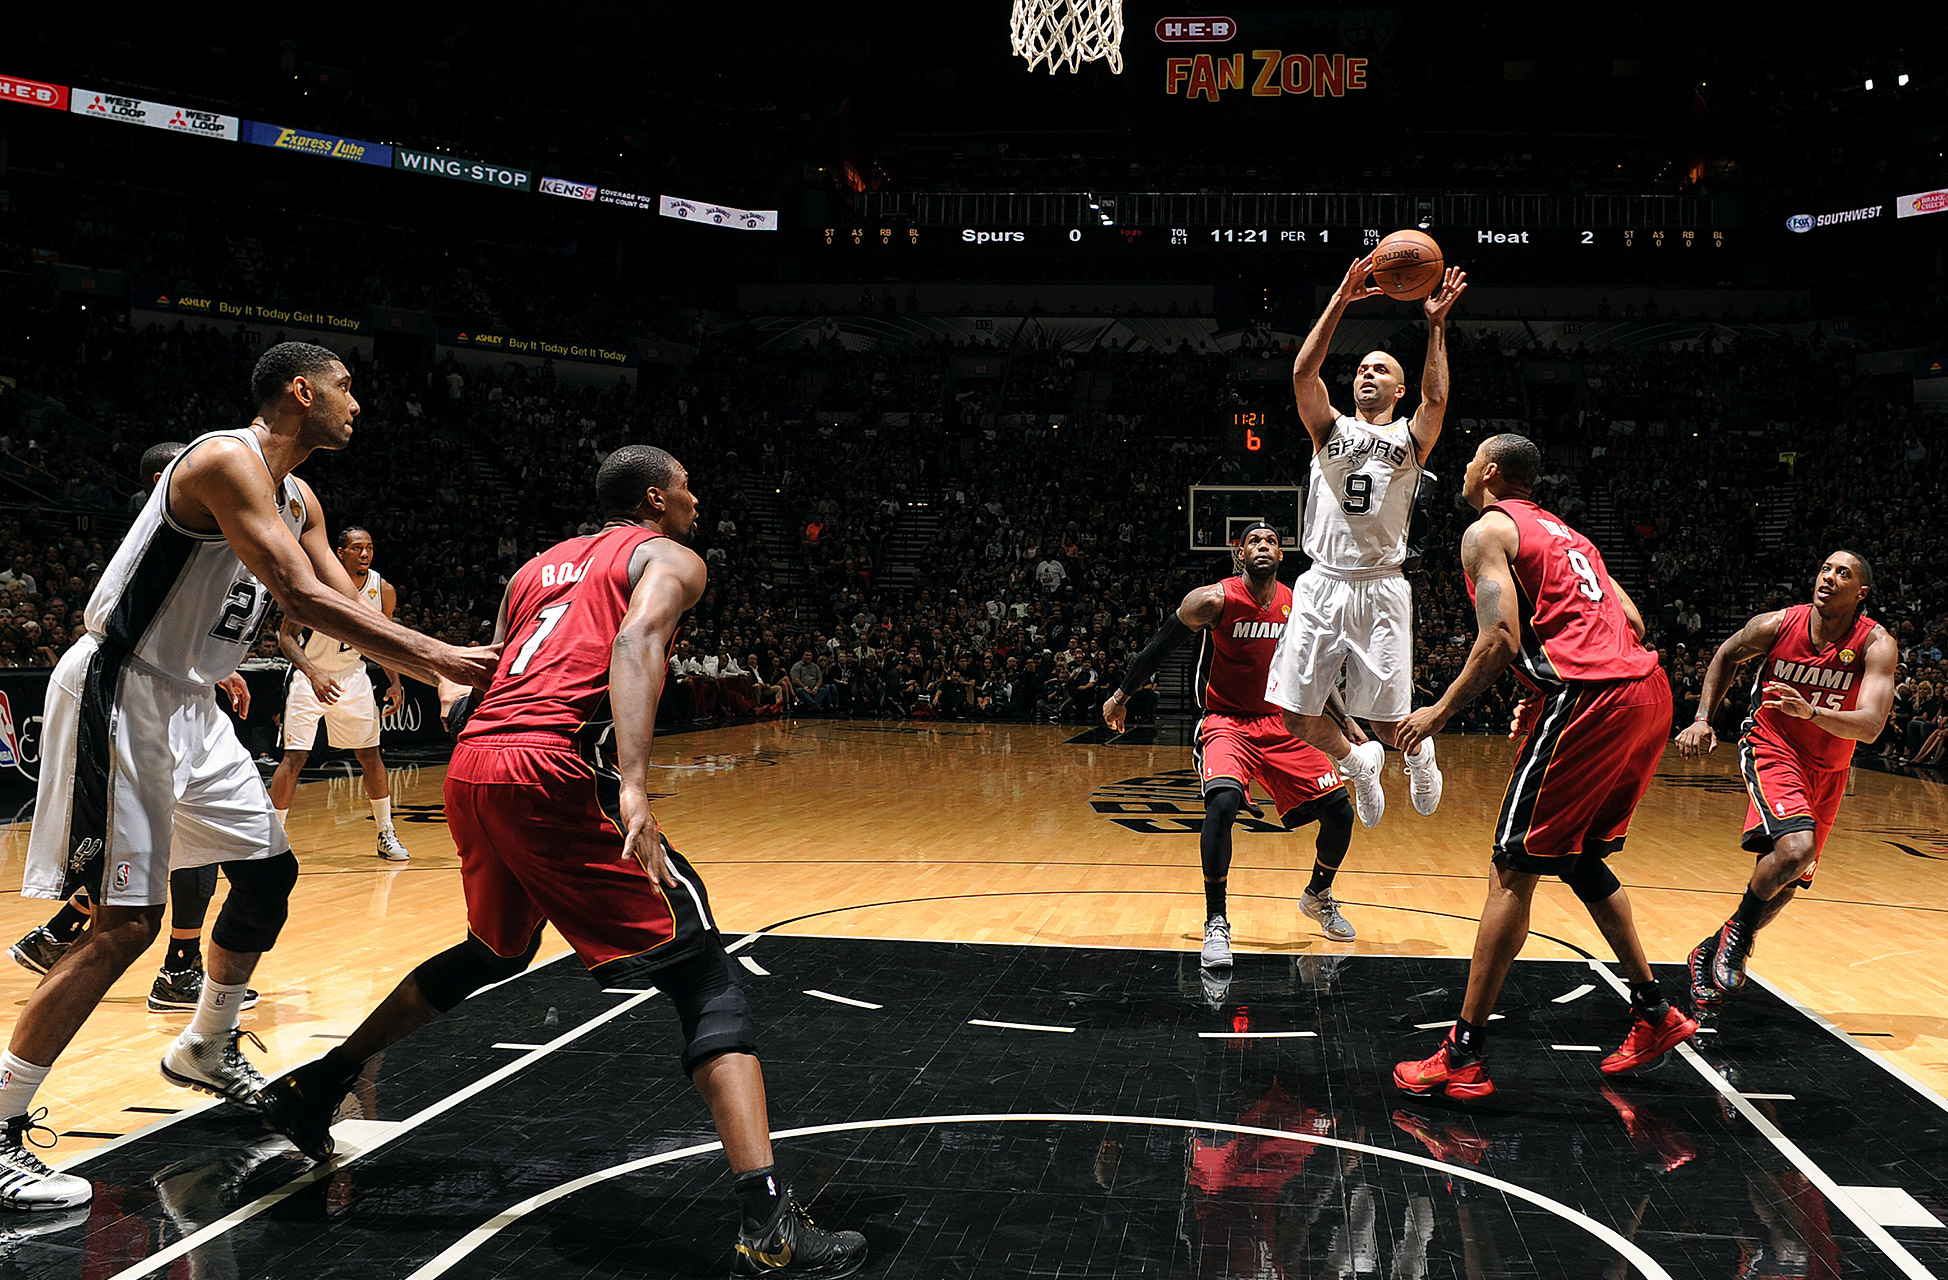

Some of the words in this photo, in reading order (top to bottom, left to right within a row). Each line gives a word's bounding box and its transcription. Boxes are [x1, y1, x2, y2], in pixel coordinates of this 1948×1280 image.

[1166, 53, 1245, 102] FAN
[1251, 49, 1368, 97] ZONE
[104, 95, 141, 109] WEST
[111, 105, 146, 118] LOOP
[185, 110, 220, 123] WEST
[192, 119, 225, 132] LOOP
[275, 128, 332, 151] Express
[331, 139, 365, 157] Lube
[600, 189, 636, 200] COVERAGE
[637, 195, 650, 203] YOU
[615, 199, 637, 207] COUNT
[1817, 205, 1882, 226] SOUTHWEST
[961, 229, 1025, 244] Spurs
[1069, 229, 1082, 241] 0
[1211, 229, 1268, 242] 11:21
[1280, 231, 1305, 241] PER
[1319, 230, 1329, 242] 1
[1363, 229, 1380, 237] TOL
[1477, 231, 1529, 244] Heat
[1581, 231, 1594, 244] 2
[1652, 231, 1664, 239] AS
[1682, 231, 1694, 239] RB
[1713, 231, 1724, 239] BL
[1656, 239, 1662, 247] 0
[1685, 239, 1691, 247] 0
[1375, 249, 1419, 268] SPALDING
[178, 298, 211, 308] ASHLEY
[219, 302, 242, 315] Buy
[245, 306, 253, 315] It
[256, 306, 291, 321] Today
[293, 311, 314, 323] Get
[316, 314, 325, 324] It
[327, 315, 360, 330] Today
[475, 334, 503, 344] ASHLEY
[509, 338, 528, 350] Buy
[530, 341, 537, 350] It
[540, 342, 568, 356] Today
[570, 346, 588, 356] Get
[589, 348, 597, 357] It
[599, 349, 627, 363] Today
[1327, 439, 1407, 466] SPURS
[1341, 473, 1376, 516] 9
[76, 515, 88, 530] 10
[1566, 549, 1604, 602] 9
[1232, 622, 1285, 639] MIAM
[508, 601, 572, 676] 1
[1773, 658, 1852, 691] MIAMI
